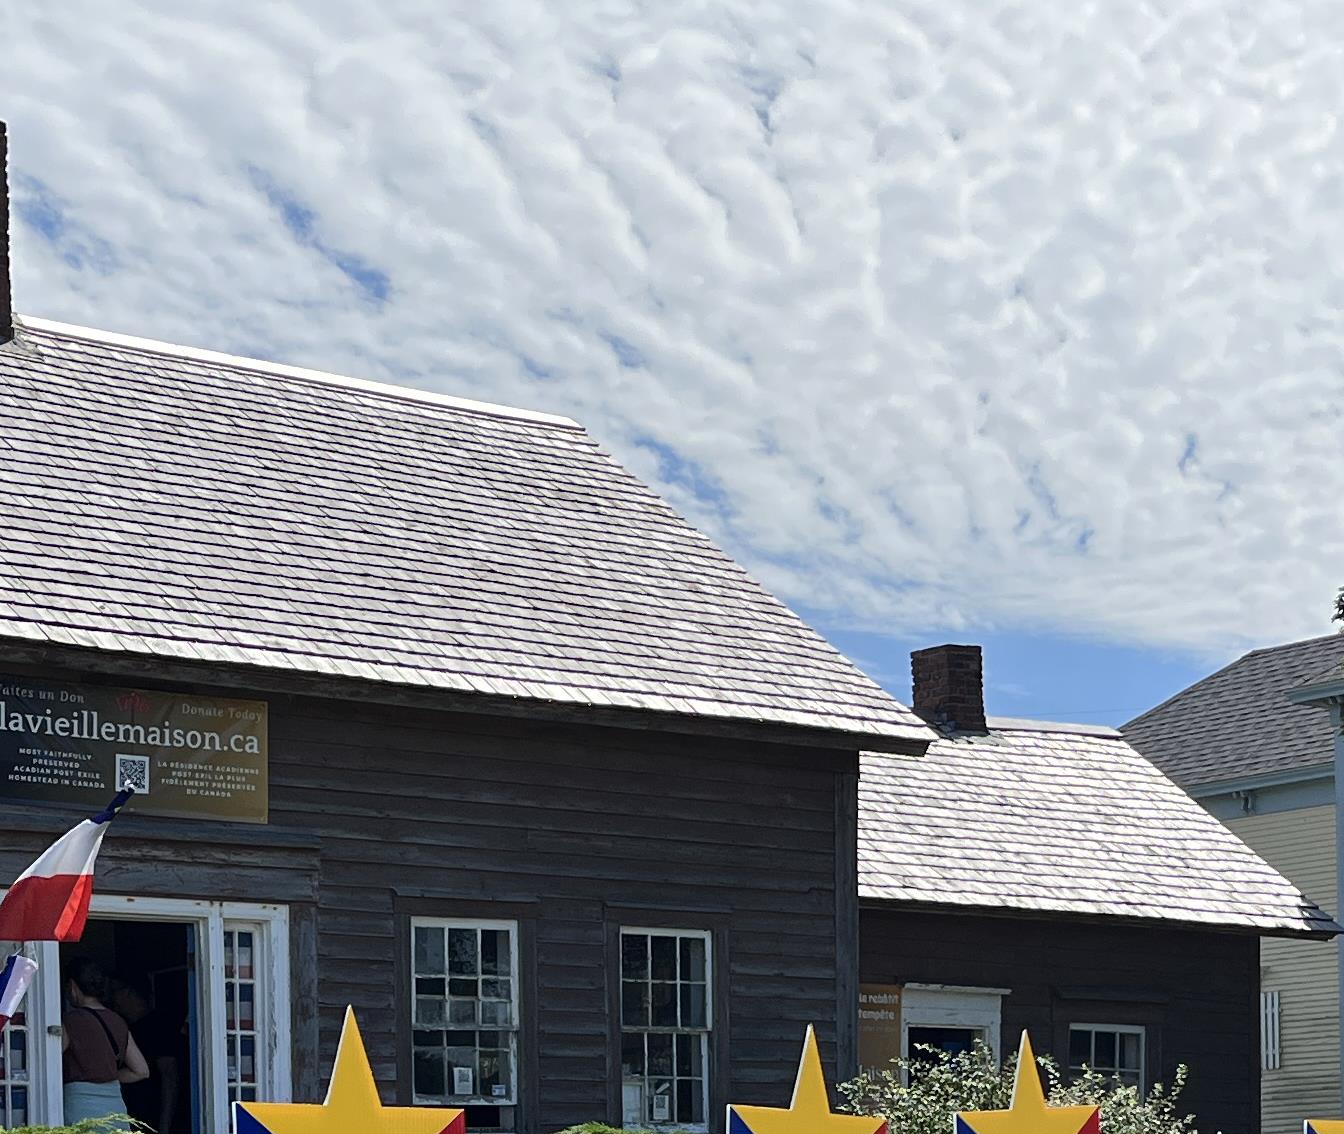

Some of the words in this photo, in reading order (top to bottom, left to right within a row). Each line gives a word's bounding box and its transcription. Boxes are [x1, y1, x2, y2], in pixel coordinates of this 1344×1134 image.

[39, 690, 55, 700] un
[60, 690, 85, 703] Don
[182, 703, 224, 718] Donate
[228, 706, 263, 724] Today
[18, 748, 42, 757] MOST
[32, 758, 80, 769] PRESERVED
[13, 765, 51, 775] ACADIAN
[53, 769, 75, 777] POST
[8, 774, 59, 785] HOMESTEAD
[72, 779, 105, 789] CANADA
